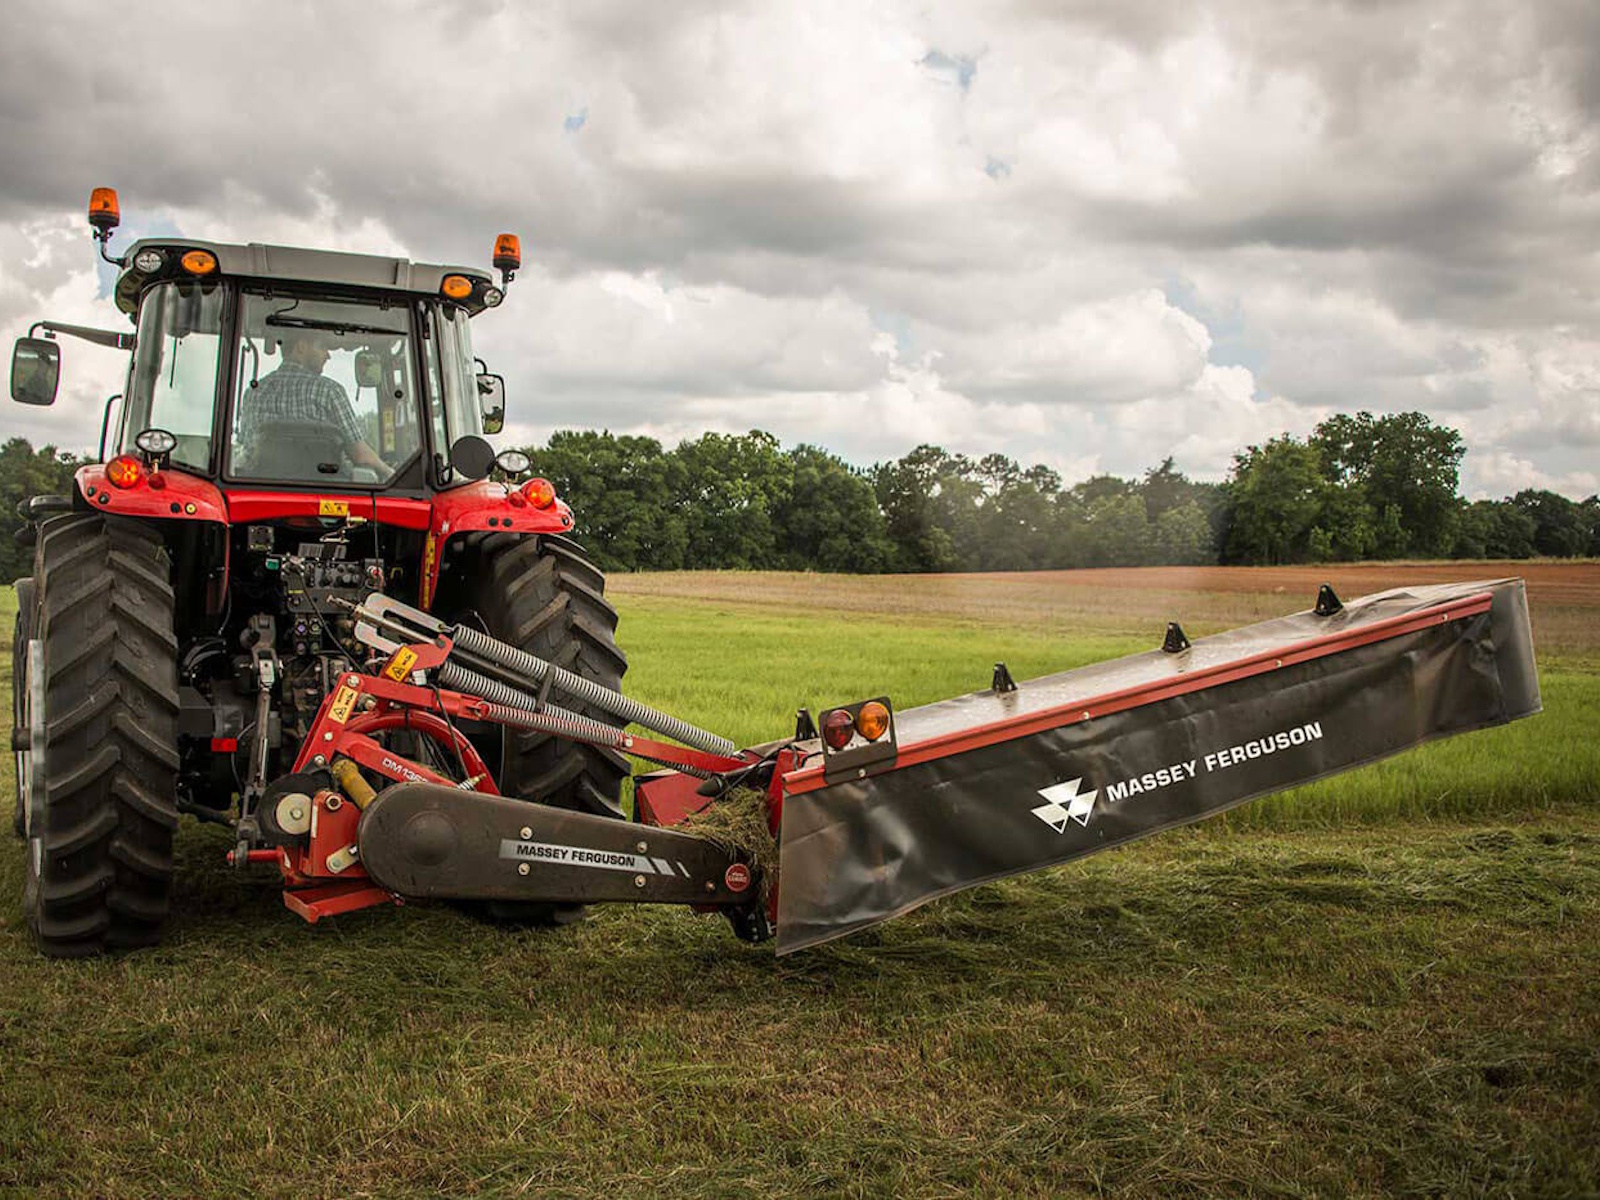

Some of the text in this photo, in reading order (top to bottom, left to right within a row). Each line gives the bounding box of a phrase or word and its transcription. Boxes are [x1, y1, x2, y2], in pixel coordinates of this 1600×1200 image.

[1106, 721, 1323, 802] MASSEY FERGUSON
[516, 844, 635, 867] MASSEY FERGUSON
